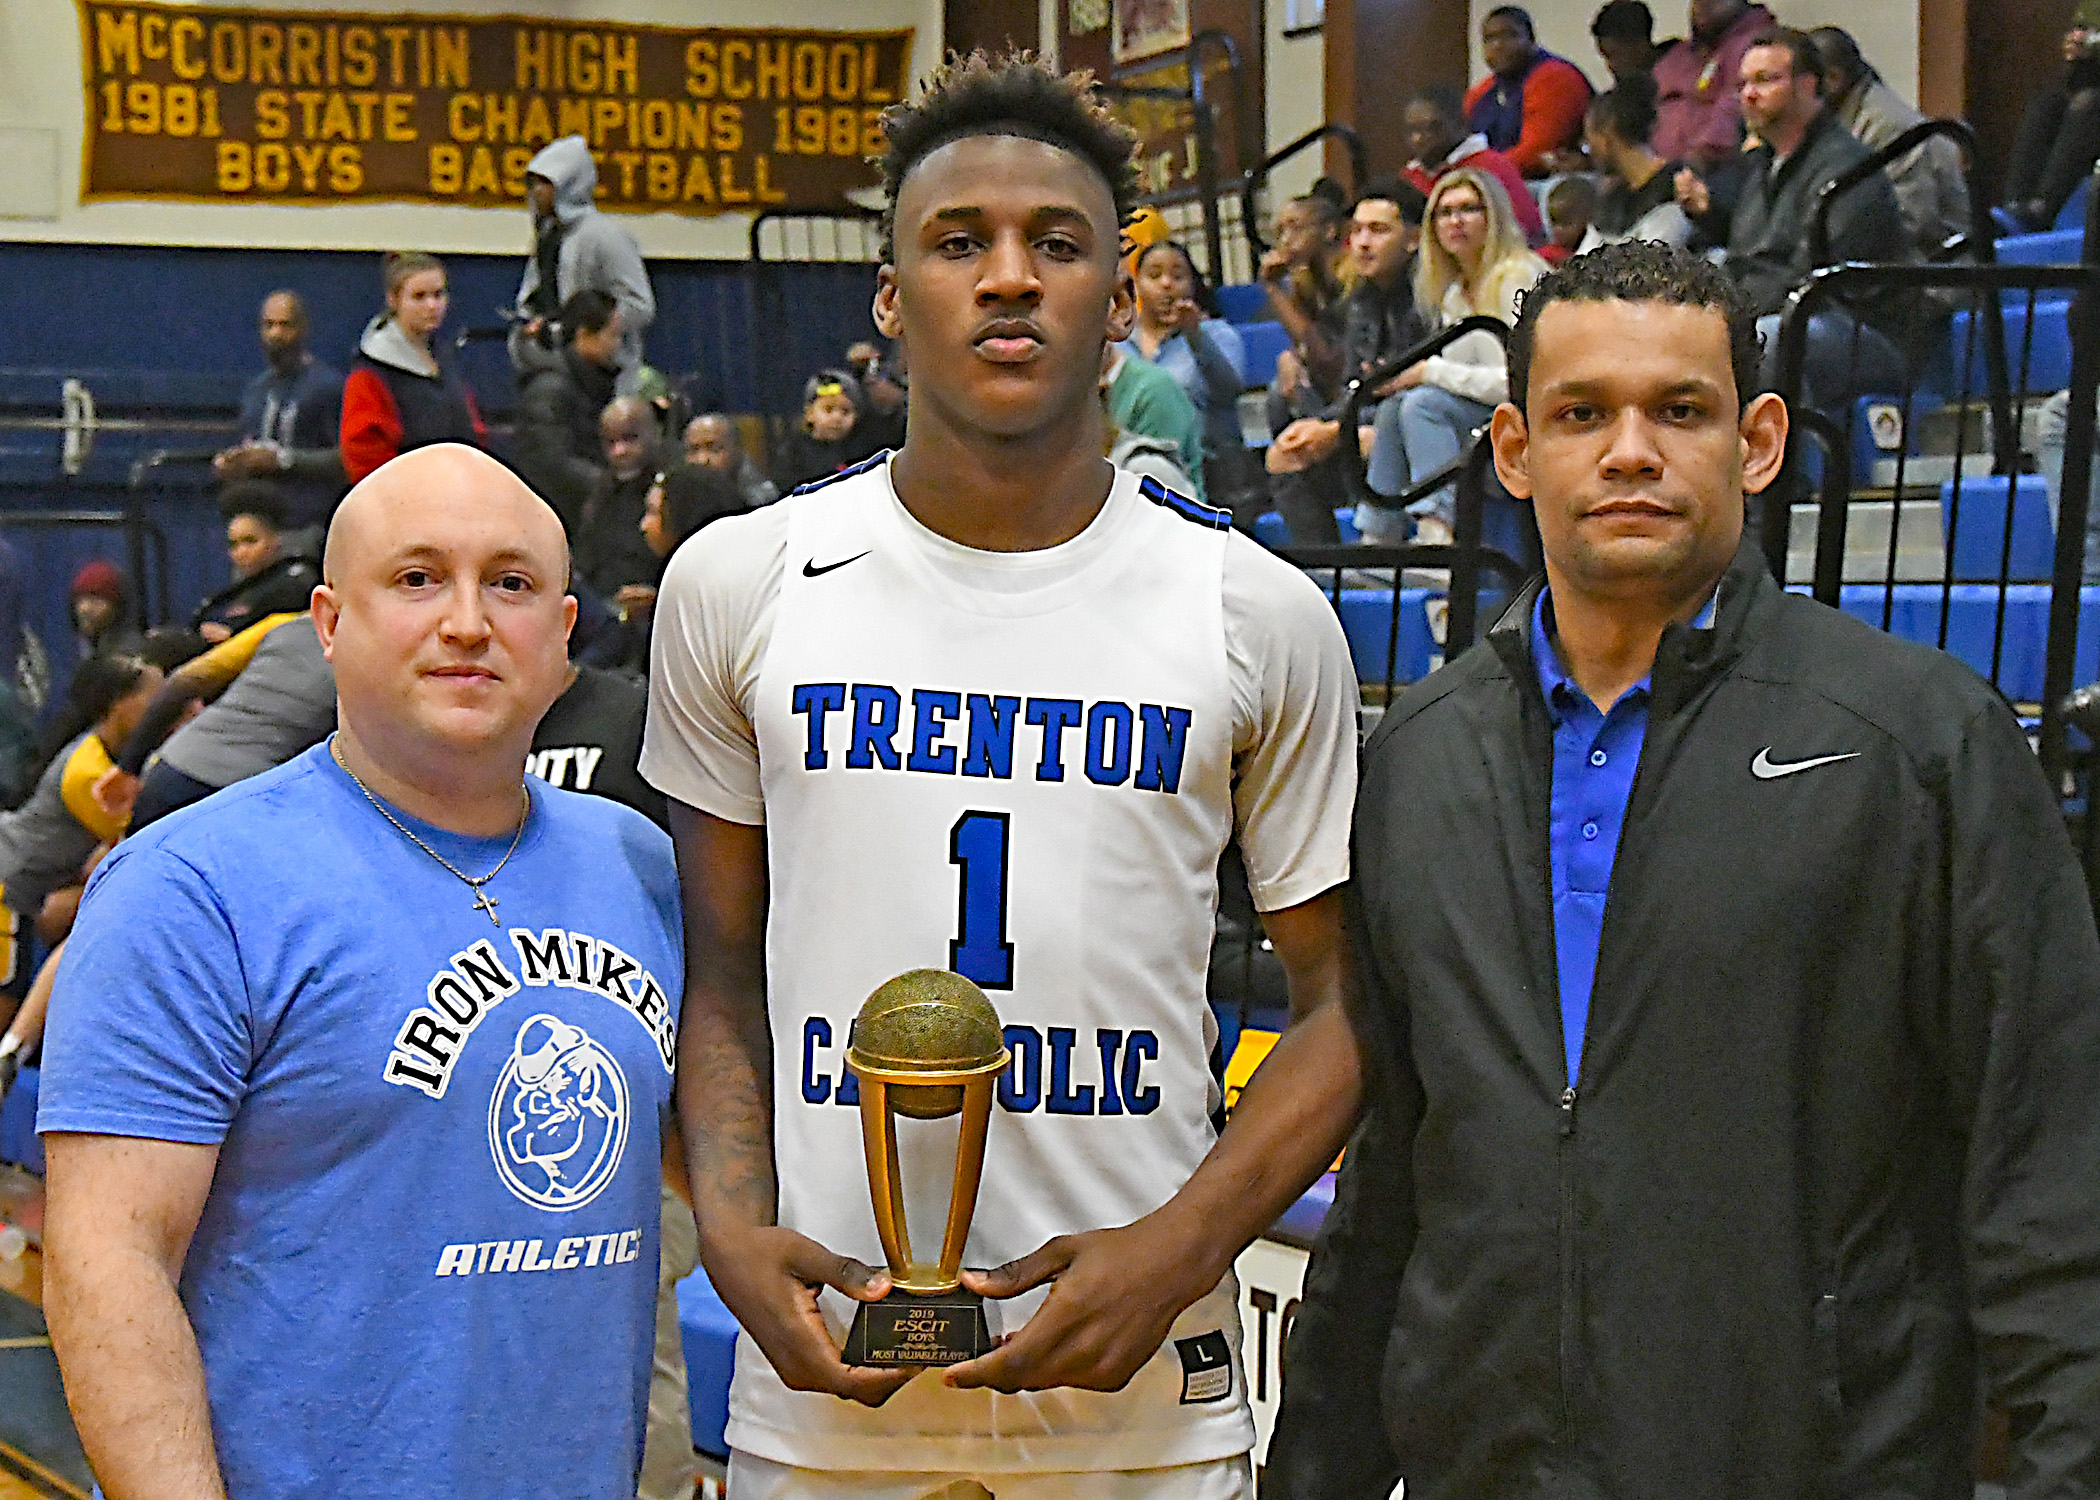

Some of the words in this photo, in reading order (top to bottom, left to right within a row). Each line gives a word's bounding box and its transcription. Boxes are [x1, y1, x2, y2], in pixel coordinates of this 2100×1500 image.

[516, 30, 638, 95] HIGH
[686, 40, 892, 101] SCHOOL
[102, 80, 222, 138] 1981
[256, 90, 418, 142] STATE
[450, 92, 743, 151] CHAMPIONS
[217, 141, 363, 193] BOYS
[430, 143, 786, 203] BASTBALL
[525, 747, 603, 790] ITY
[792, 683, 1192, 795] TRENTON
[949, 809, 1014, 991] 1
[383, 939, 521, 1099] IRON
[508, 929, 676, 1075] MIKES
[801, 1016, 1160, 1117] COLIC
[893, 1319, 950, 1332] ESCIT
[907, 1333, 935, 1342] BOYS
[909, 1309, 935, 1319] 2019
[872, 1350, 896, 1359] MOST
[898, 1350, 938, 1360] VALUABLE
[939, 1351, 970, 1360] PLAYER
[1197, 1344, 1213, 1362] L
